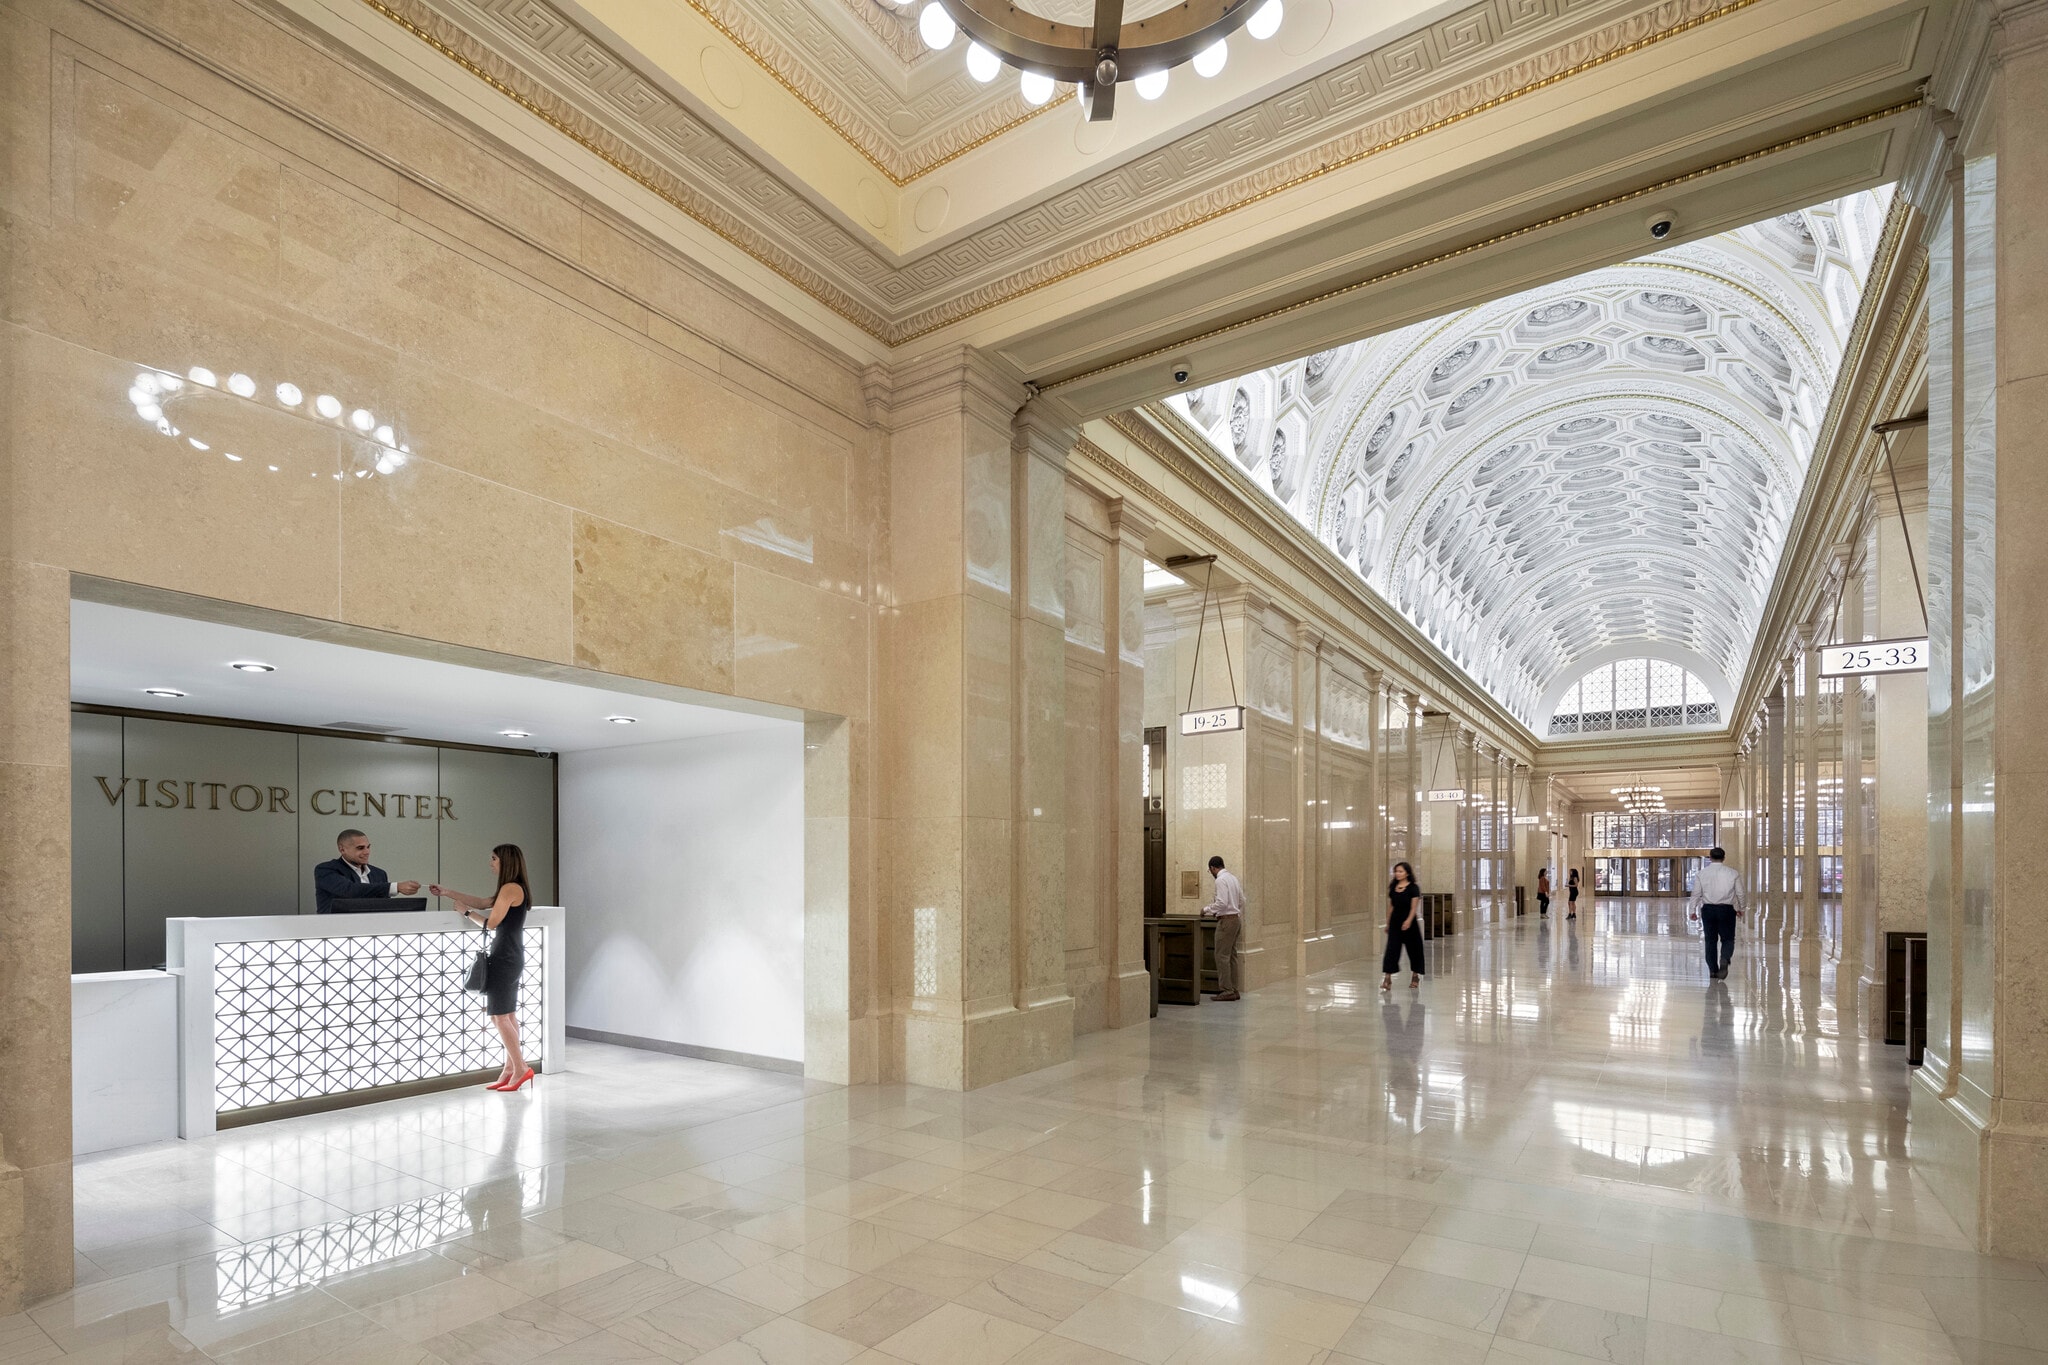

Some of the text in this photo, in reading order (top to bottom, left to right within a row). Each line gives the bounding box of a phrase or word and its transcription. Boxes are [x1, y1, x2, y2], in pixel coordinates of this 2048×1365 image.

[1841, 646, 1917, 670] 25-33
[1193, 713, 1228, 730] 19-25
[93, 776, 459, 821] VISITOR CENTER
[1432, 791, 1459, 800] 33-40
